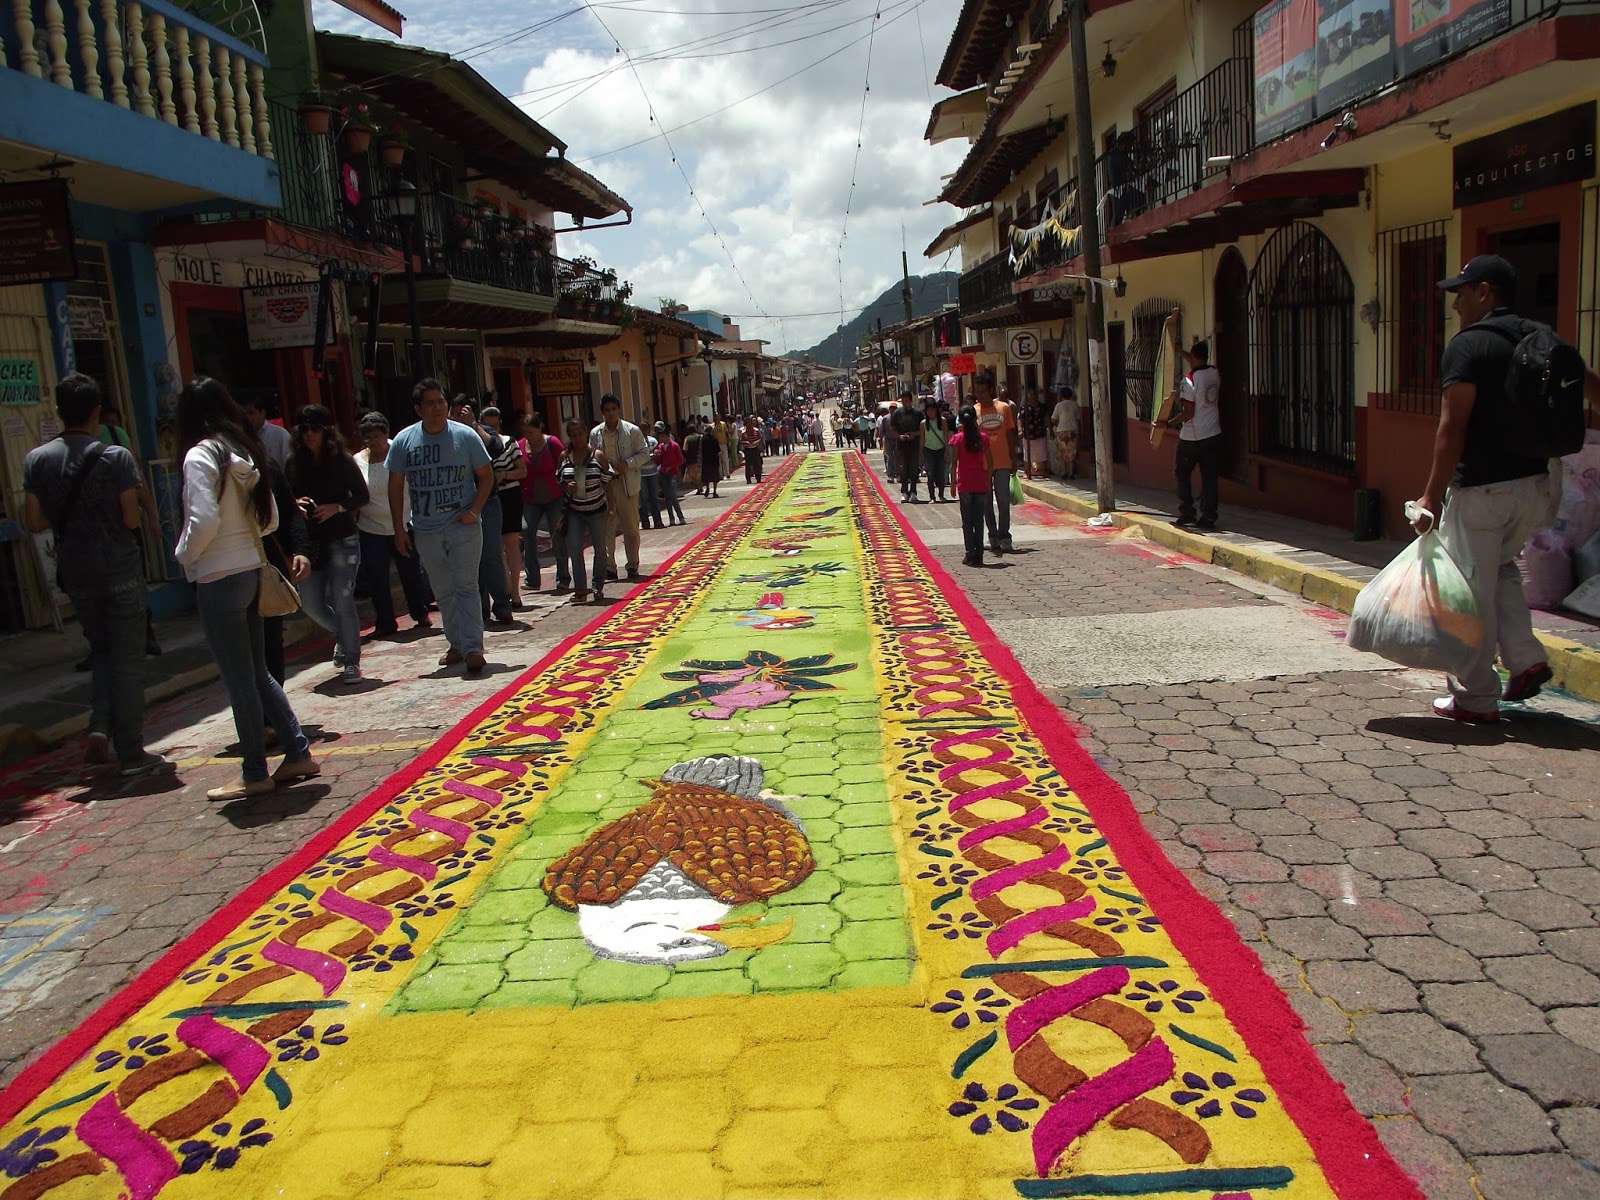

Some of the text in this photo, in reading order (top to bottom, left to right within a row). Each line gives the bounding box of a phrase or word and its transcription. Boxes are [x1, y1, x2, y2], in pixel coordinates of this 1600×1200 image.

[1454, 143, 1593, 190] ARQUITECTOS
[177, 258, 222, 284] MOLE
[252, 285, 319, 297] MOLE CHARITO
[56, 299, 76, 372] CAF
[1019, 336, 1032, 356] E
[0, 361, 33, 380] CAFÉ
[406, 444, 440, 467] AERO
[434, 485, 464, 505] DEPT
